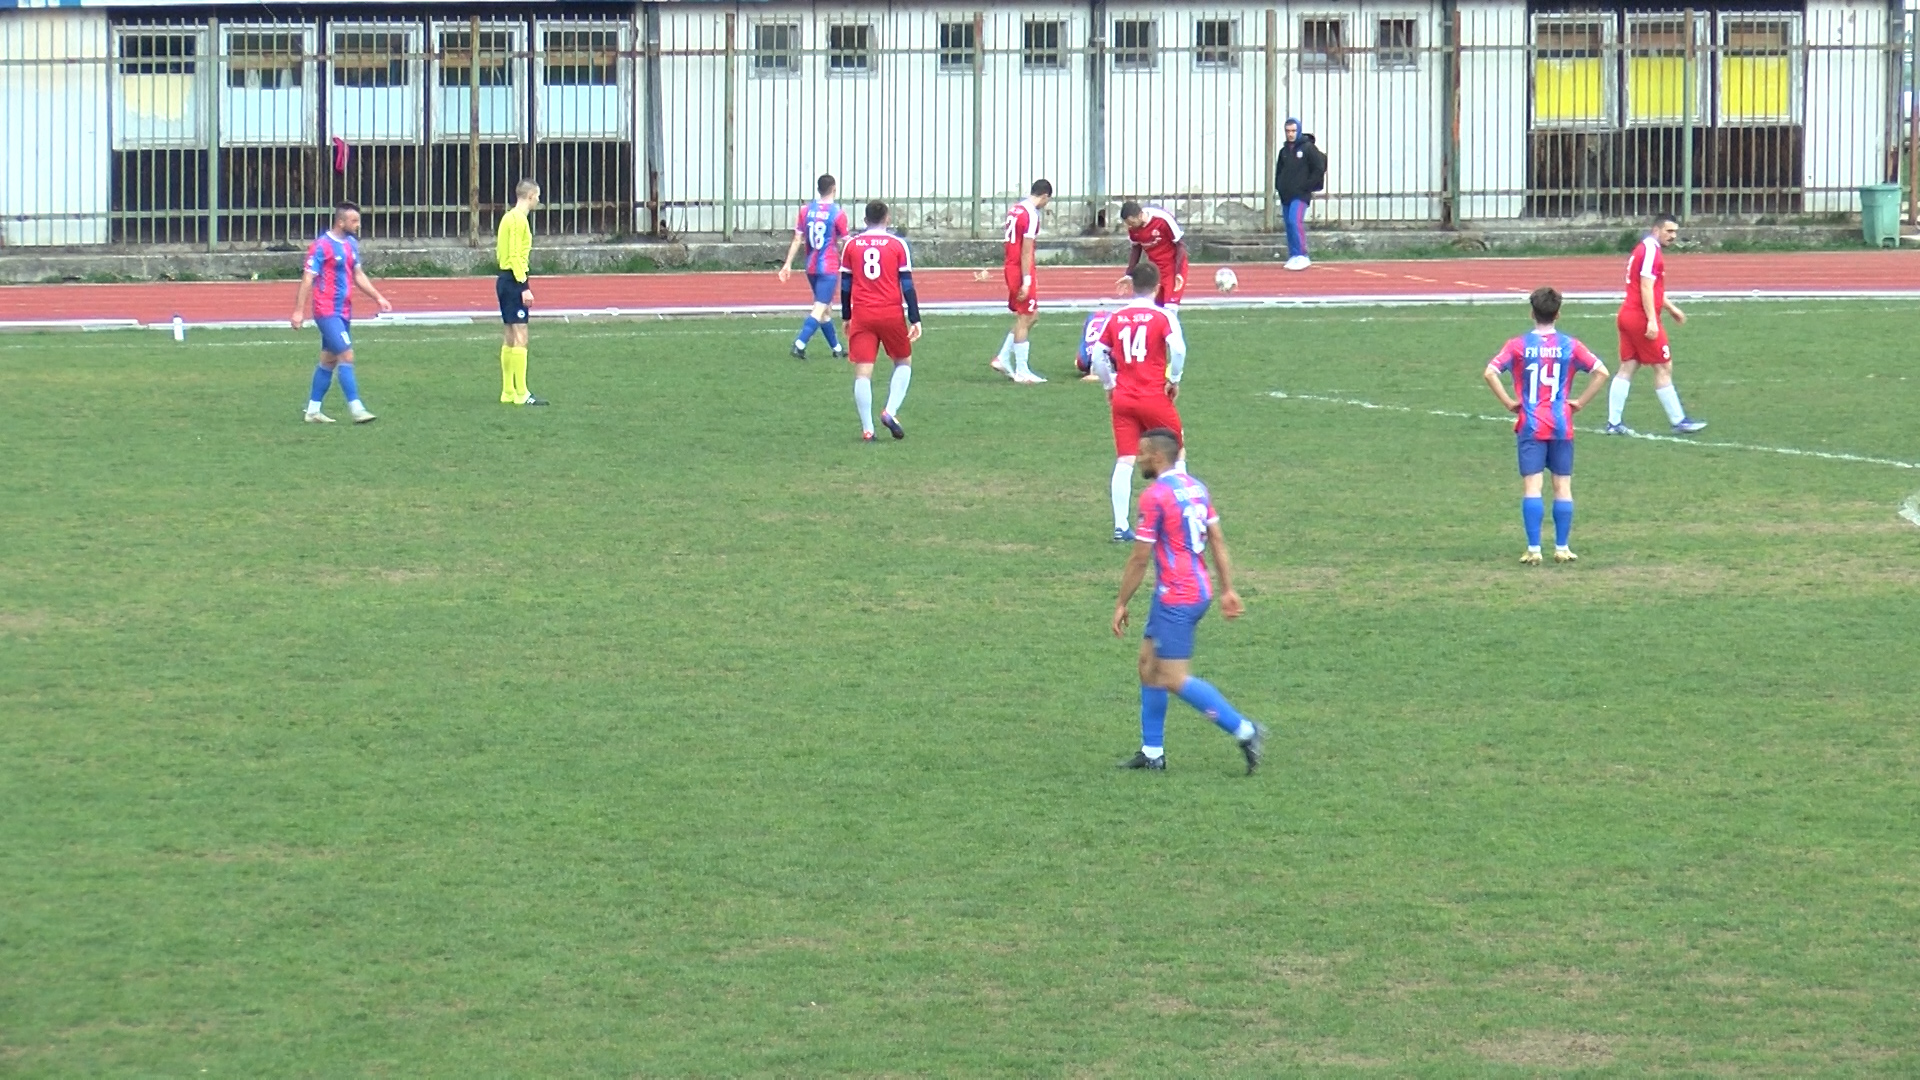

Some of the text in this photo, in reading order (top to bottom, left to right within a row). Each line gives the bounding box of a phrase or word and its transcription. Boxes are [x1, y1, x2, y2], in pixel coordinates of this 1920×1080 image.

[806, 220, 827, 250] 18
[863, 246, 881, 280] 8
[1118, 325, 1148, 364] 14
[1525, 362, 1561, 404] 14
